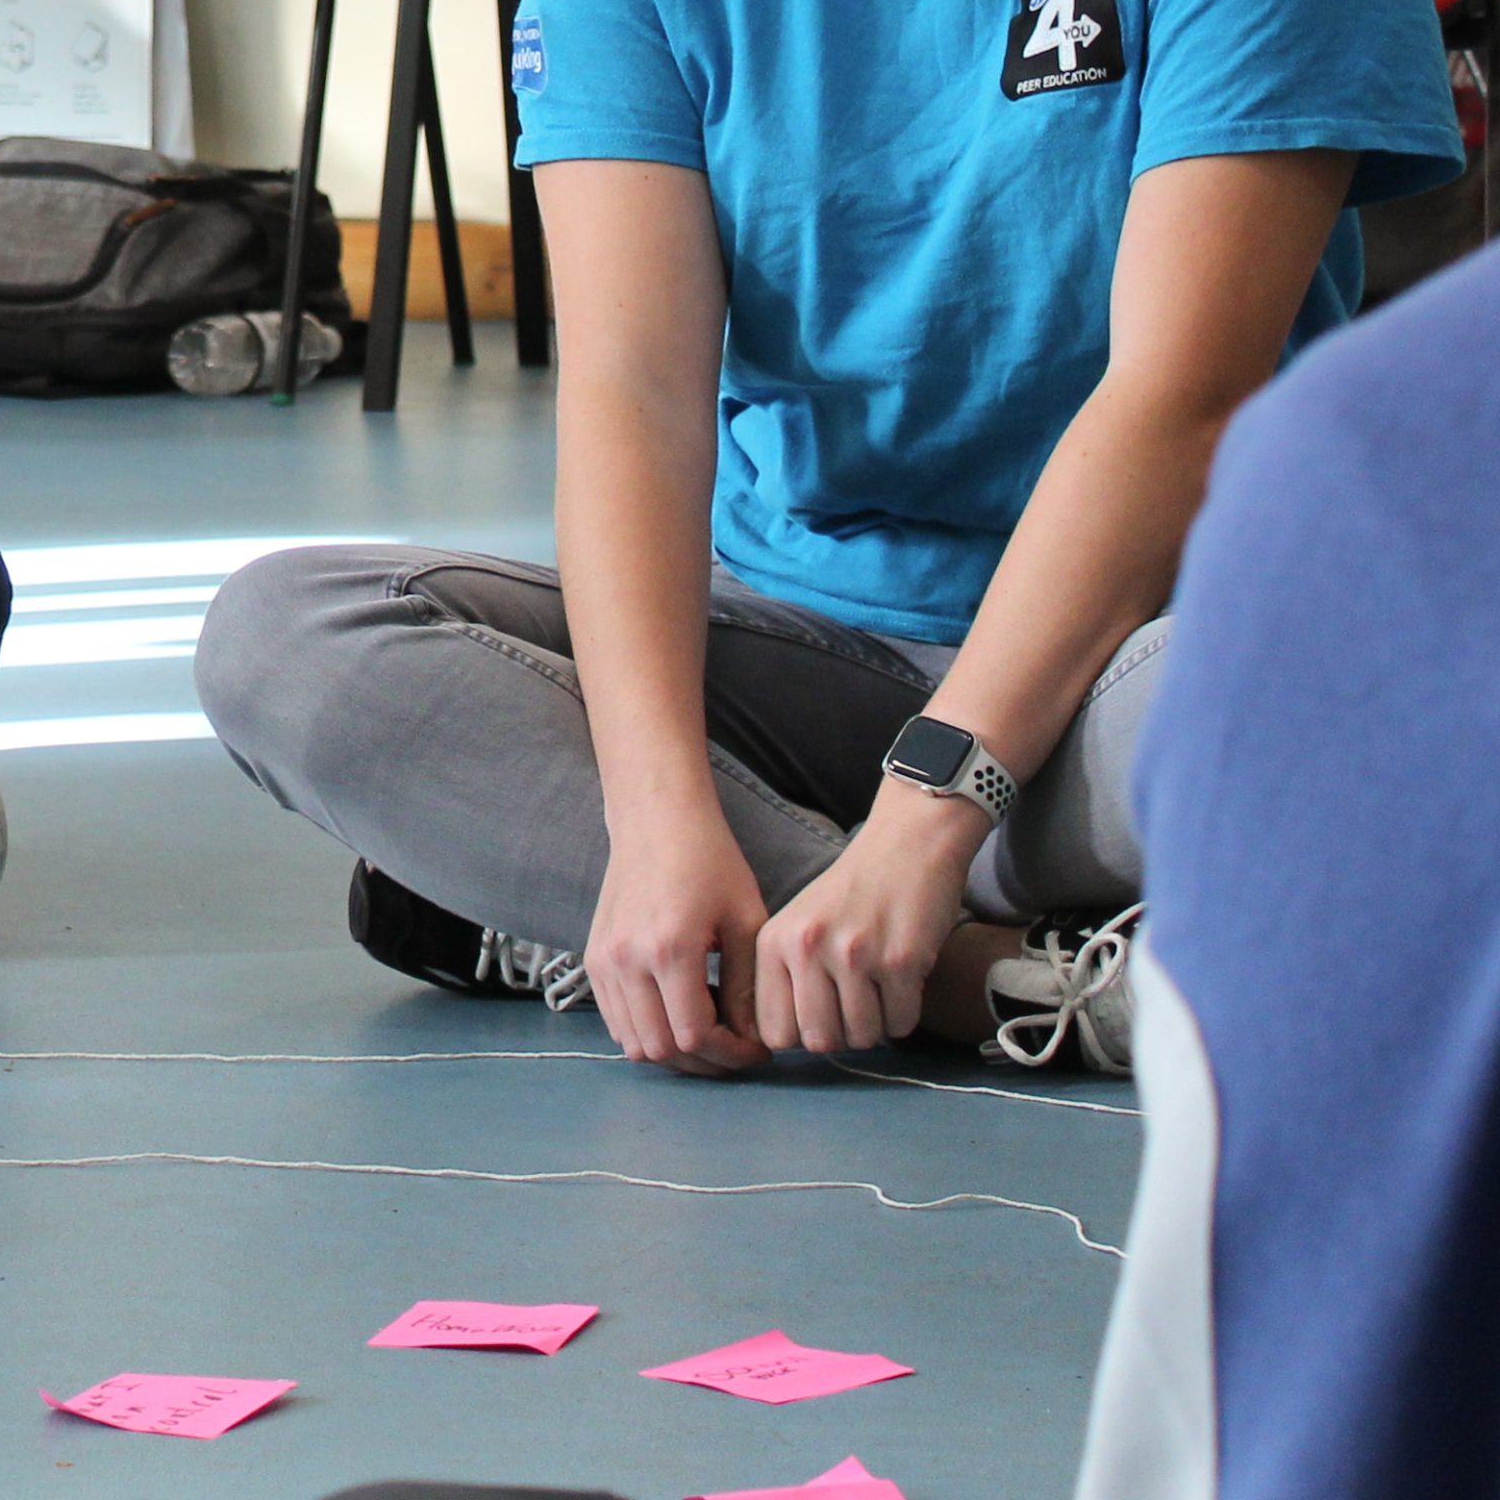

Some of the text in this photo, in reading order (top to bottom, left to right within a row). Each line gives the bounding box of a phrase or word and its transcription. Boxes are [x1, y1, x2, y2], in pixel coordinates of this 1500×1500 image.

[1063, 25, 1092, 41] YOU
[1016, 67, 1107, 95] PEER EDUCATION
